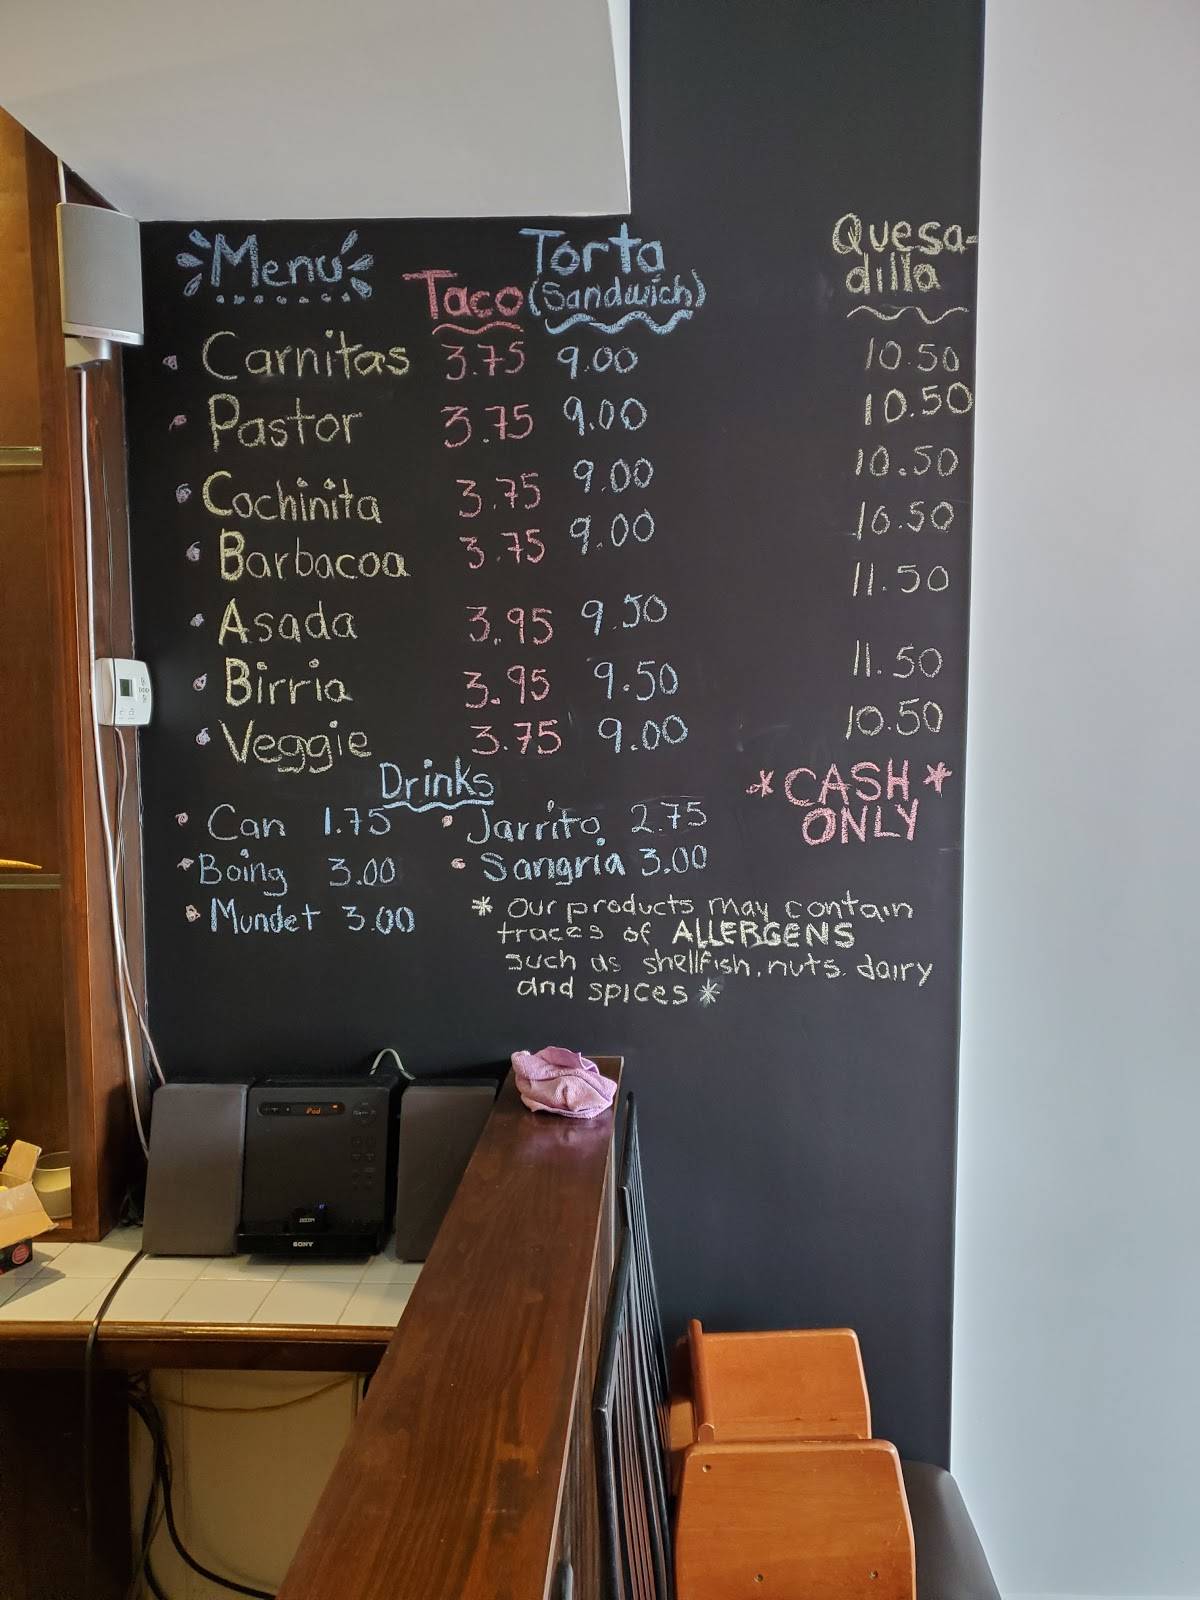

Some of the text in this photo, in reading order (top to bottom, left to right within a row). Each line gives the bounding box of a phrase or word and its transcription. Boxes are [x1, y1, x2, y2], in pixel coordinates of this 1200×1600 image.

[518, 222, 664, 275] Torta
[830, 212, 977, 254] Quesa-
[402, 268, 523, 320] Taco
[528, 267, 707, 317] (Sandwich)
[845, 252, 942, 294] dilla
[201, 329, 960, 382] Carnitas 3.75 9.00 10.50
[205, 380, 975, 452] Pastor 3.75 9.00 10.50
[200, 445, 960, 525] Cochinita 3.75 9.00 10.50
[217, 500, 956, 582] Barbacoa 3.75 9.00 10.50
[217, 560, 951, 646] Asada 3.95 9.50 11.50
[224, 638, 944, 710] Birria 3.95 9.50 11.50
[216, 697, 945, 775] Veggie 3.75 9.00 10.50
[379, 758, 495, 799] Drinks
[784, 757, 910, 806] CASH
[206, 803, 393, 841] Can 1.75
[466, 800, 710, 844] Jarrito 2.75
[801, 798, 920, 846] ONLY
[198, 848, 397, 897] Boing 3.00
[481, 837, 709, 886] Sangria 3.00
[208, 898, 417, 936] Mundet 3.00
[507, 890, 914, 923] Our products may contain
[496, 920, 856, 949] traces of ALLERGENS
[504, 948, 578, 972] such
[590, 955, 622, 974] as
[857, 954, 933, 987] dairy
[515, 977, 690, 1007] and spices
[292, 1240, 314, 1248] SONY
